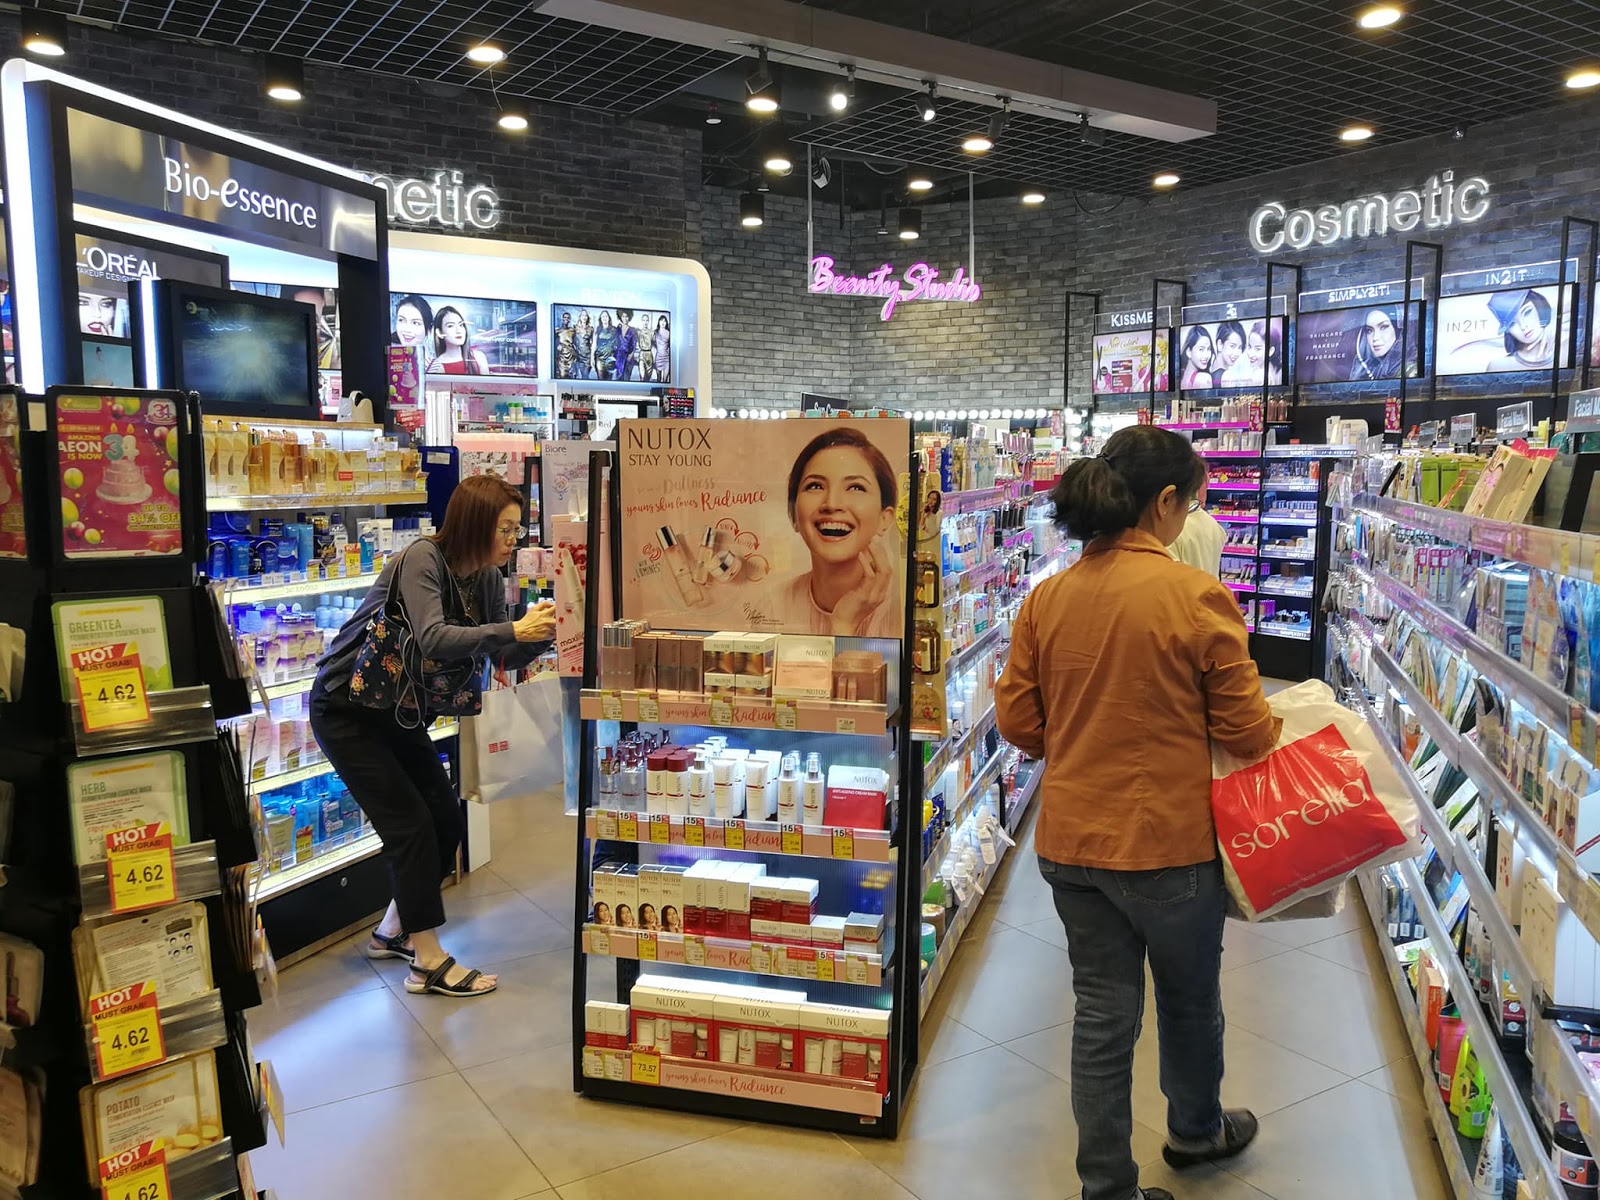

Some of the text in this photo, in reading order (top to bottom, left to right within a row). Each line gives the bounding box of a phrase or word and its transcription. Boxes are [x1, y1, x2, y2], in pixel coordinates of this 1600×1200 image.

[163, 157, 318, 230] Bio-essence
[1248, 168, 1491, 254] Cosmetic
[1484, 269, 1528, 286] IN2IT
[810, 254, 982, 321] Beauty Studio
[1446, 319, 1488, 333] IN2IT
[1309, 331, 1343, 339] SKINCARE
[1305, 353, 1346, 361] FRAGRANCE
[628, 427, 711, 450] NUTOX
[58, 441, 102, 453] AEON
[628, 454, 712, 467] STAY YOUNG
[626, 489, 767, 517] young skin loves Radiance
[69, 618, 122, 634] GREENTEA
[77, 645, 115, 666] HOT
[805, 649, 828, 657] NUTOX
[78, 663, 104, 672] MUST
[98, 683, 137, 704] 4.62
[805, 688, 828, 696] NUTOX
[665, 707, 690, 720] young
[733, 707, 776, 723] Radian
[853, 775, 878, 784] NUTOX
[80, 781, 107, 795] HERB
[619, 812, 629, 820] 15
[651, 814, 661, 822] 15
[686, 816, 696, 824] 15
[1230, 778, 1371, 859] sorella
[783, 824, 793, 832] 15
[834, 829, 844, 837] 15
[112, 826, 147, 847] HOT
[111, 843, 134, 853] MUST
[126, 864, 165, 885] 4.62
[706, 950, 726, 962] loves
[97, 987, 132, 1011] HOT
[655, 997, 686, 1008] NUTOX
[94, 1010, 118, 1020] MUST
[739, 1007, 771, 1018] NUTOX
[826, 1016, 859, 1028] NUTOX
[111, 1026, 150, 1050] 4.62
[638, 1062, 657, 1073] 73.57
[665, 1071, 786, 1095] young skin loves Radiance
[106, 1096, 140, 1115] POTATO
[106, 1146, 141, 1173] HOT
[105, 1168, 129, 1181] MUST
